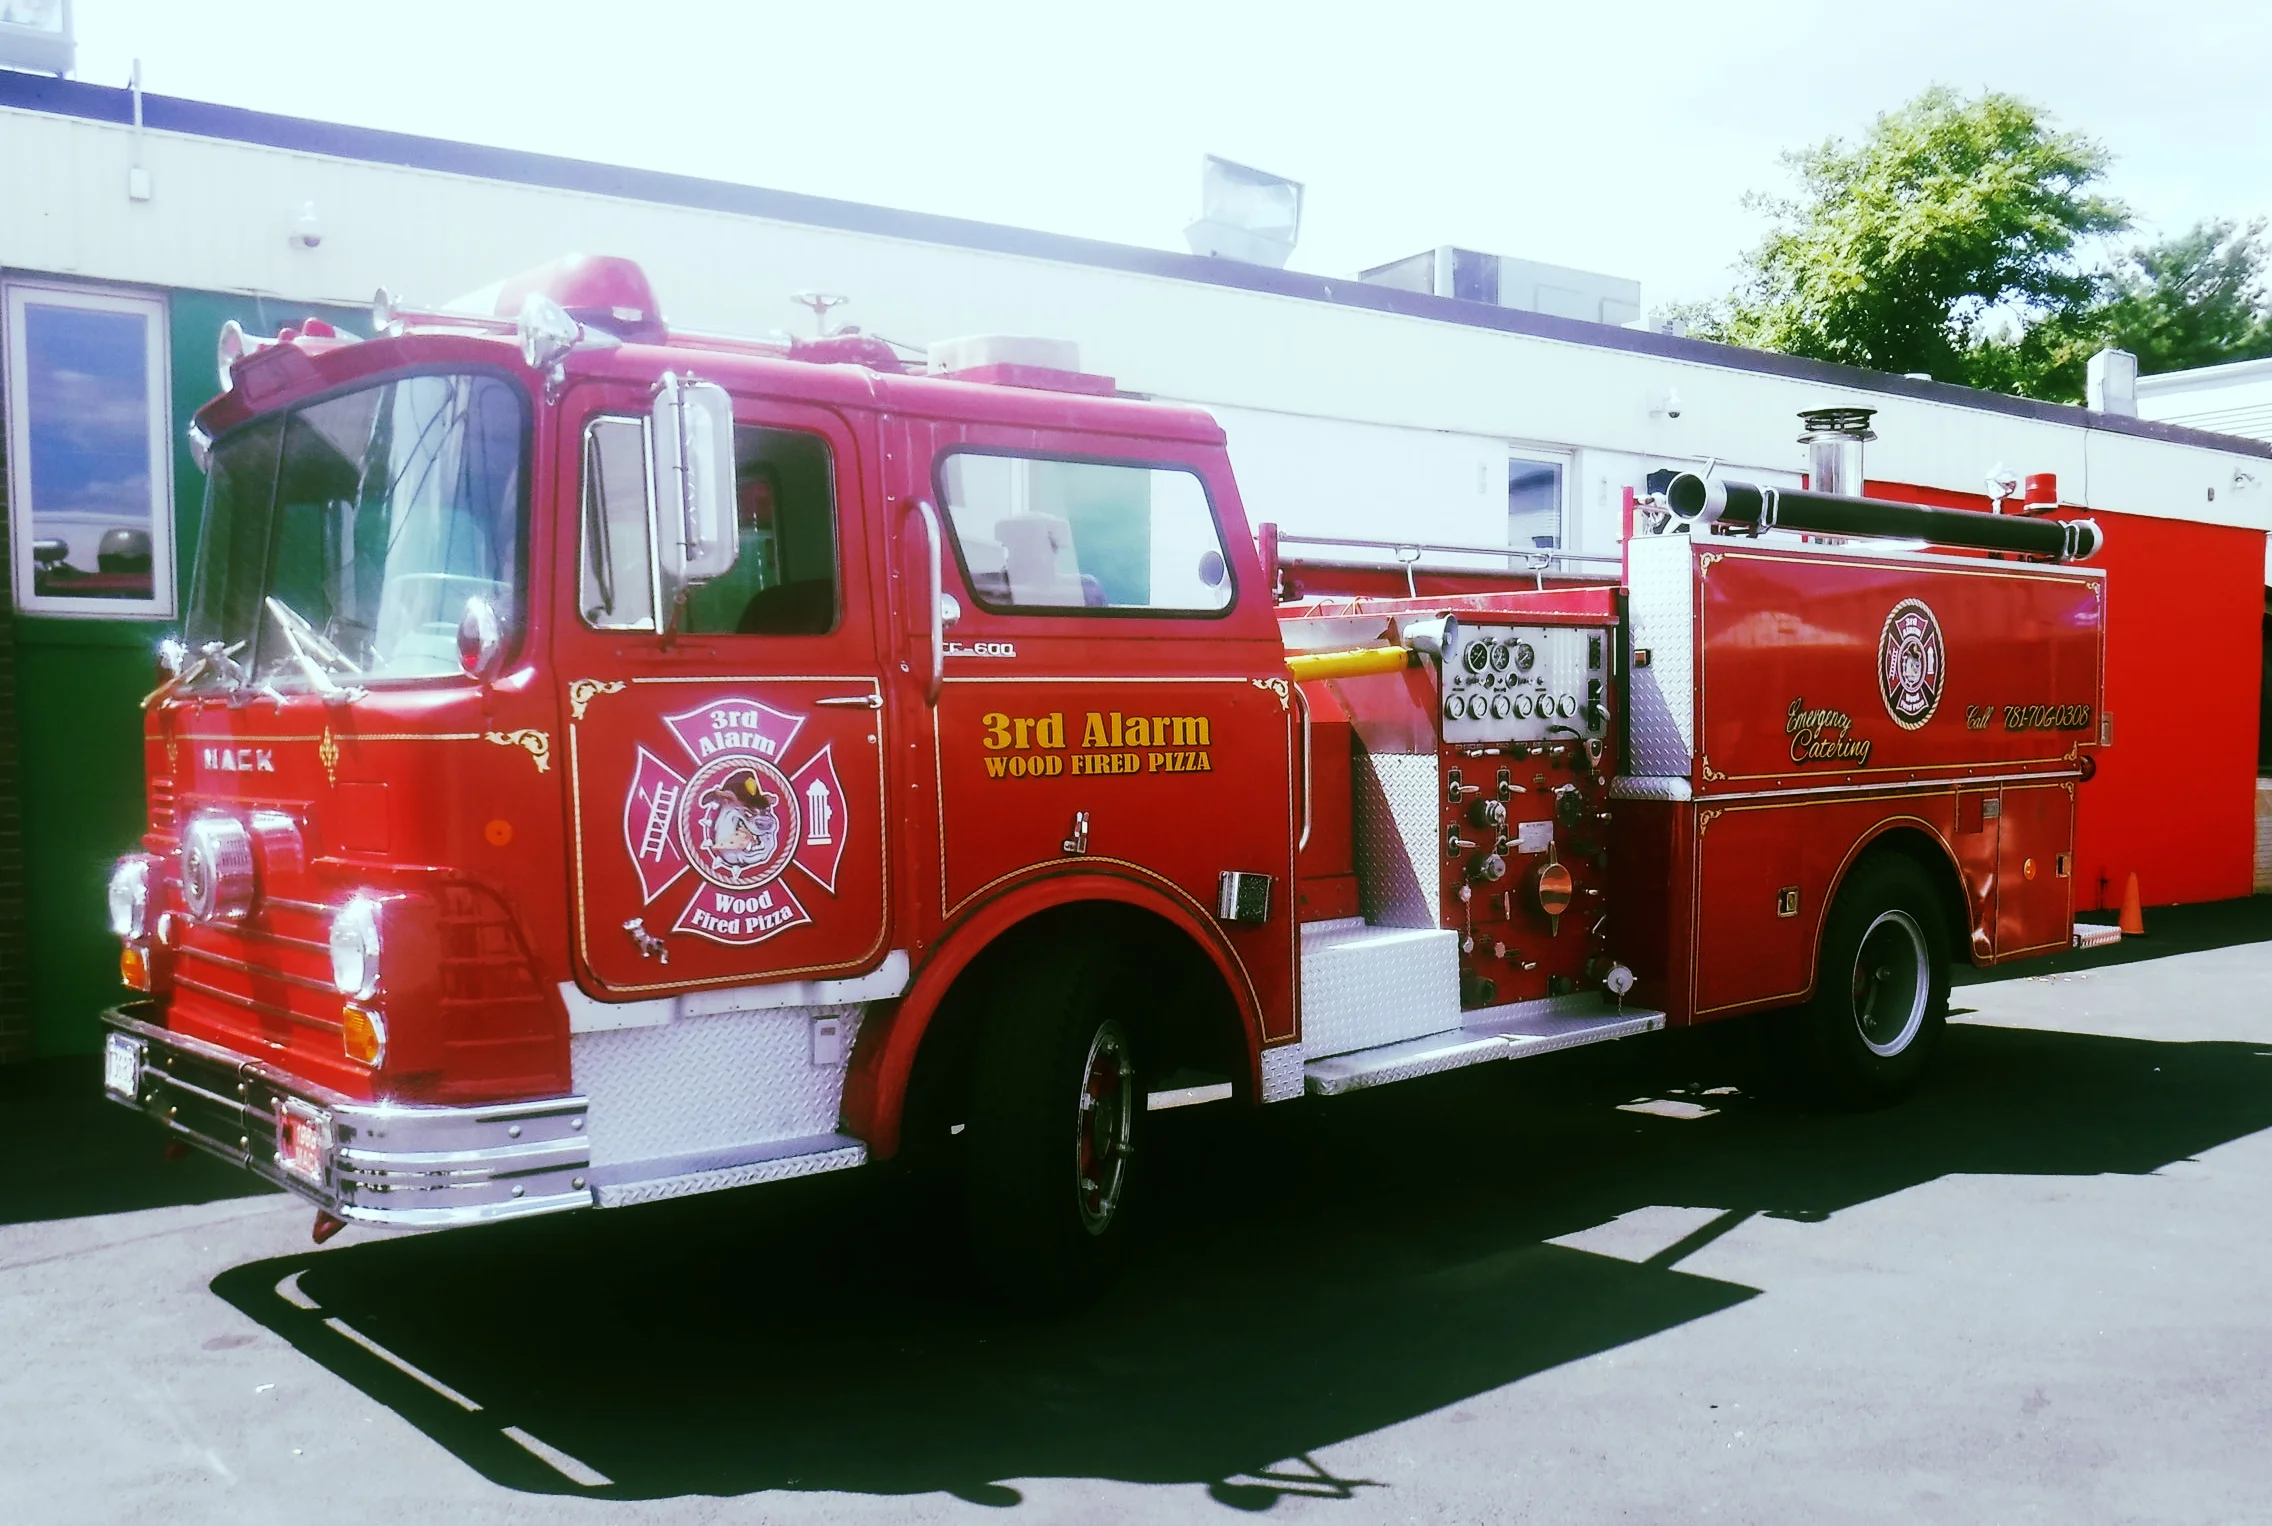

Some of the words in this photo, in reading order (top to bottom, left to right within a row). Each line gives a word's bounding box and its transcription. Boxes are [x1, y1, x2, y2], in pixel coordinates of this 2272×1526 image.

[709, 709, 758, 730] 3rd
[1787, 697, 1852, 739] Emergency
[1966, 704, 1994, 729] Call
[2003, 704, 2090, 729] 781-706-0308
[699, 730, 777, 757] Alarm
[982, 712, 1066, 750] 3rd
[1081, 712, 1211, 748] Alarm
[1791, 728, 1870, 765] Catering
[204, 748, 275, 773] MACK
[983, 754, 1063, 778] WOOD
[1070, 752, 1140, 775] FIRED
[1148, 751, 1212, 773] PIZZA
[714, 889, 773, 915] Wood
[690, 908, 740, 935] Fired
[745, 904, 794, 934] Pizza
